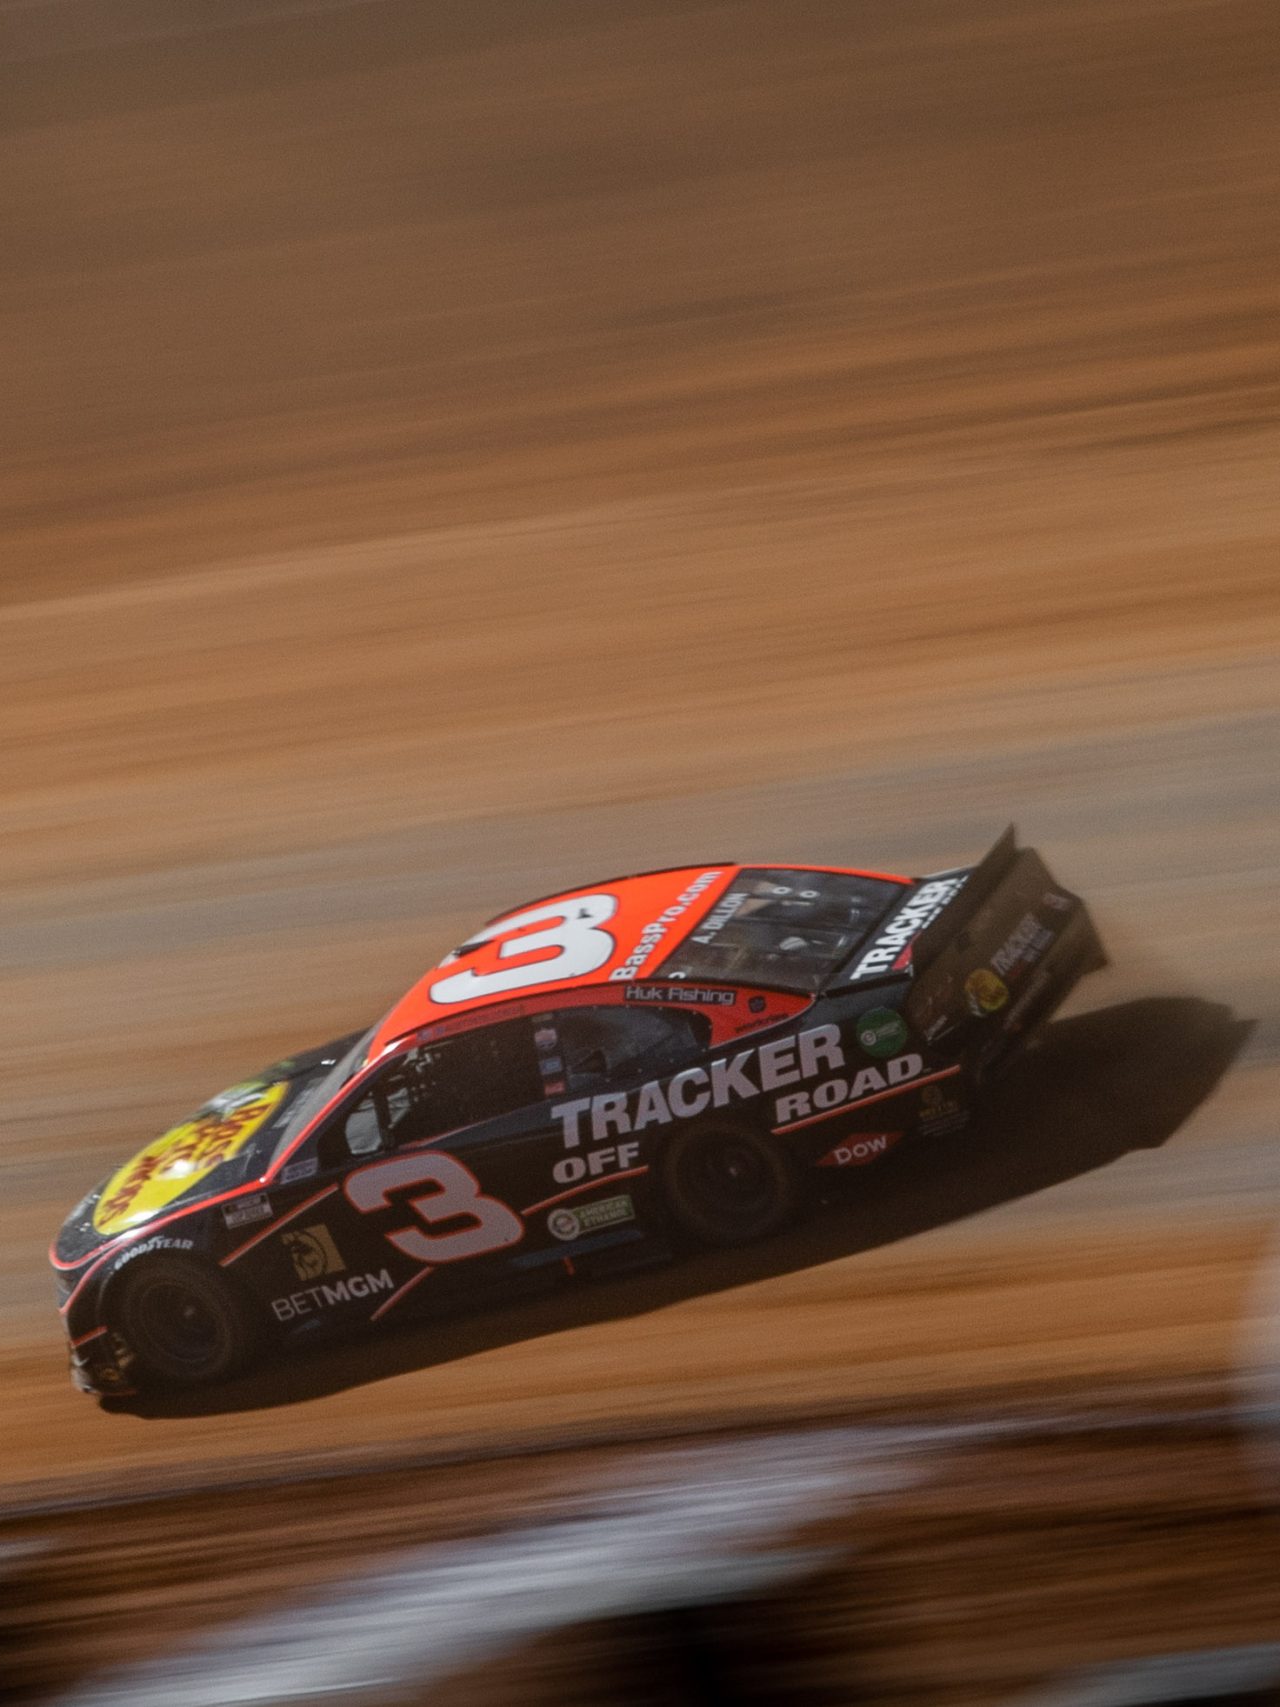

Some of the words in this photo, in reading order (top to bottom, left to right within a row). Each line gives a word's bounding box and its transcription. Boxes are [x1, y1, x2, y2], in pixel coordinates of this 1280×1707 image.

[429, 892, 618, 1005] 3
[607, 871, 724, 981] BassPro.com
[701, 892, 749, 931] DILLON
[850, 877, 960, 980] TRACKER
[626, 986, 665, 1000] Huk
[669, 987, 735, 1005] Fishing
[551, 1023, 846, 1149] TRACKER
[552, 1141, 639, 1184] OFF
[775, 1053, 923, 1124] ROAD
[114, 1235, 194, 1270] GOODYEAR
[343, 1149, 523, 1264] 3
[271, 1268, 395, 1322] BETMGM
